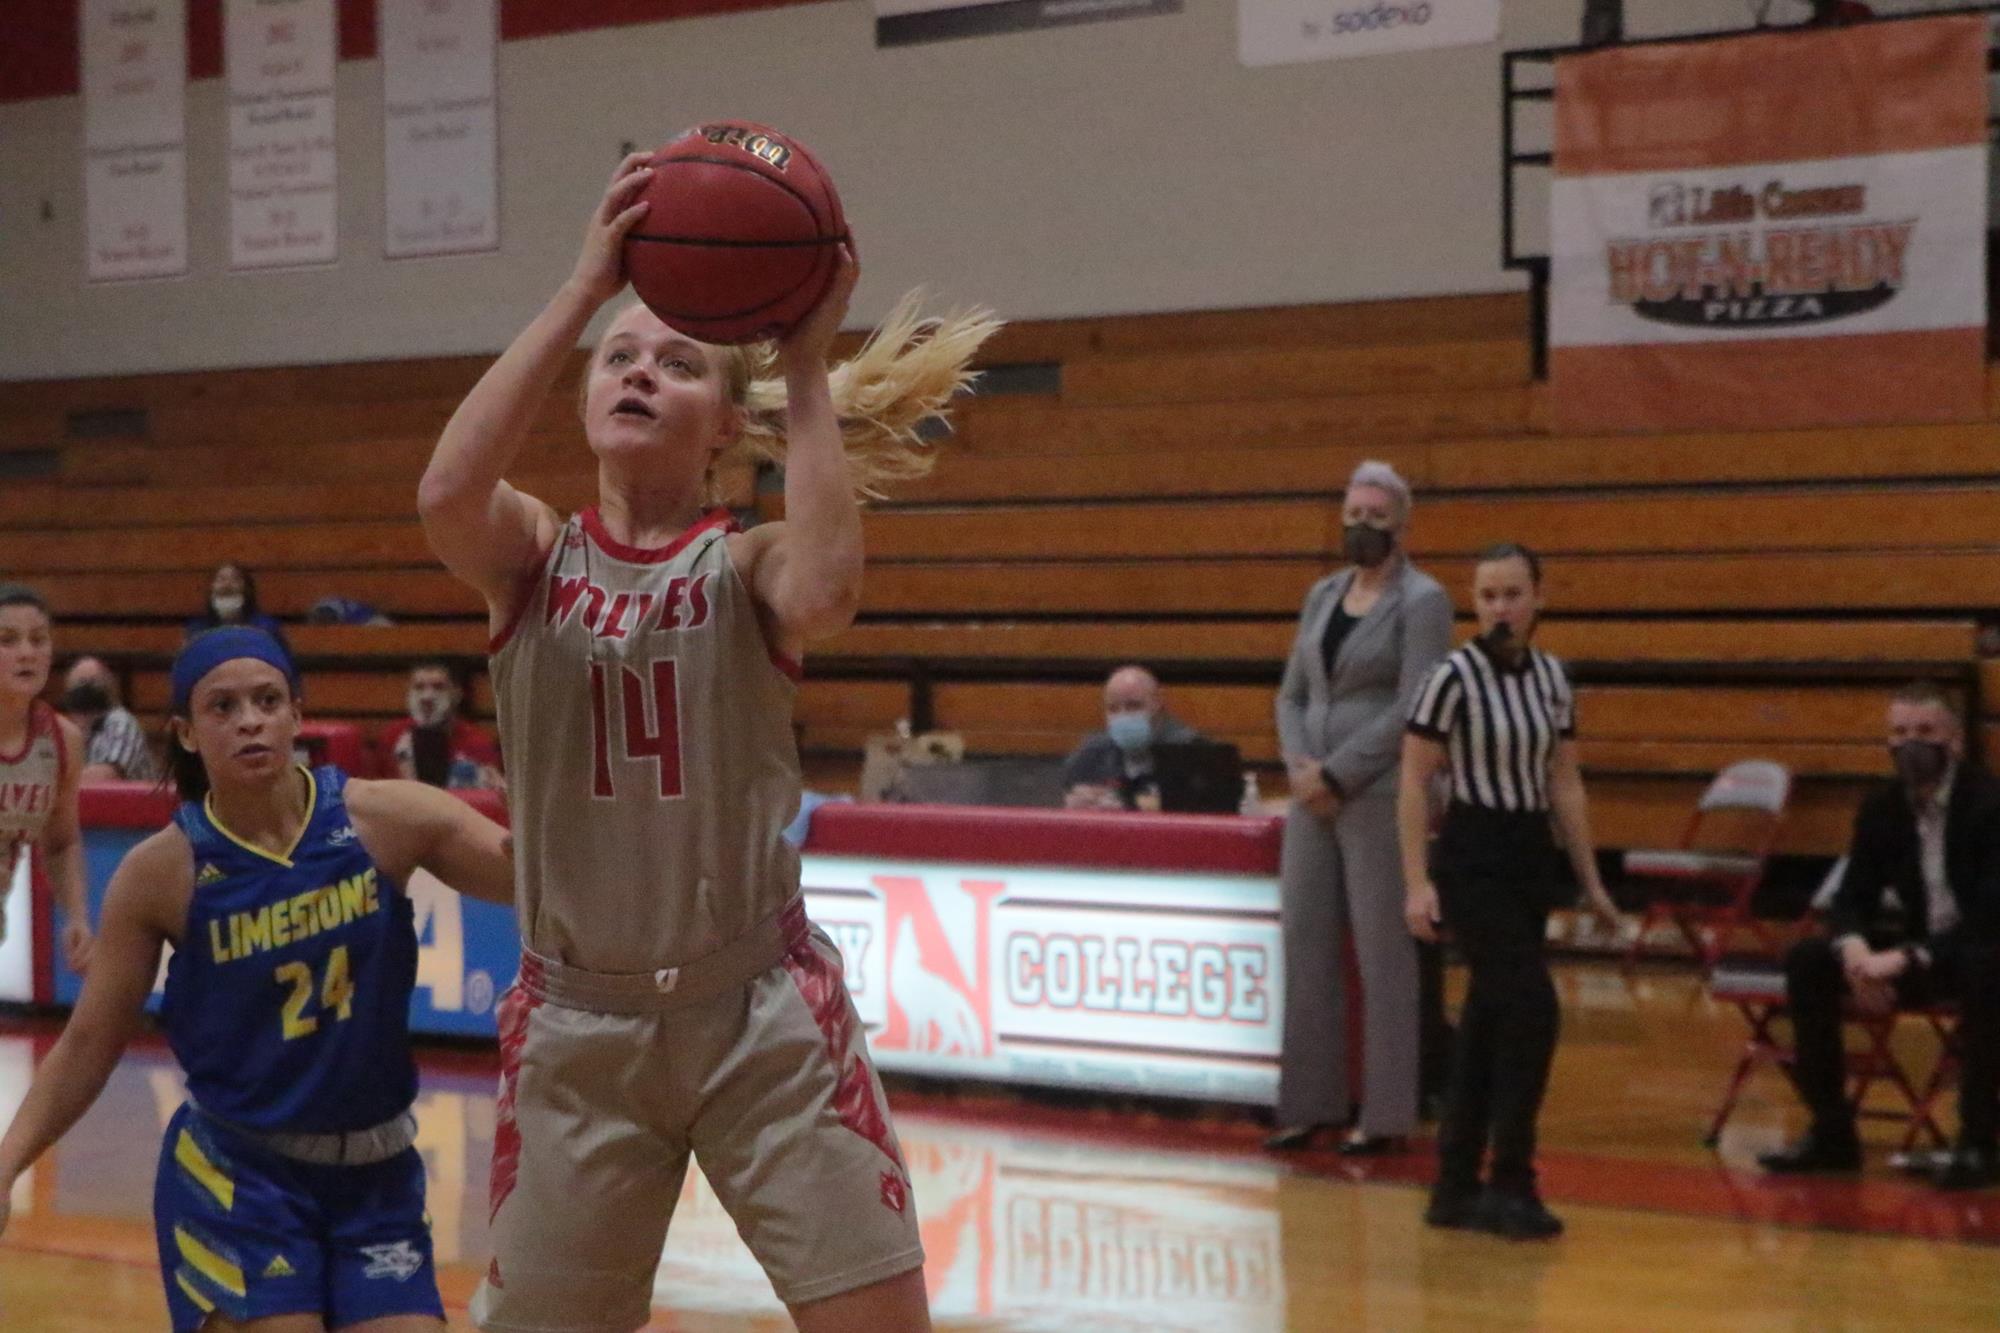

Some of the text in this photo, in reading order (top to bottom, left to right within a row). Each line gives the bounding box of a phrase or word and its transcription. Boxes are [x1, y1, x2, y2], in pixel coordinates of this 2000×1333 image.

[1703, 296, 1824, 323] PIZZA
[544, 570, 713, 641] WOLVES
[588, 655, 686, 800] 14
[209, 867, 380, 965] LIMESTONE
[274, 944, 355, 1041] 24
[1006, 930, 1271, 1024] COLLEGE
